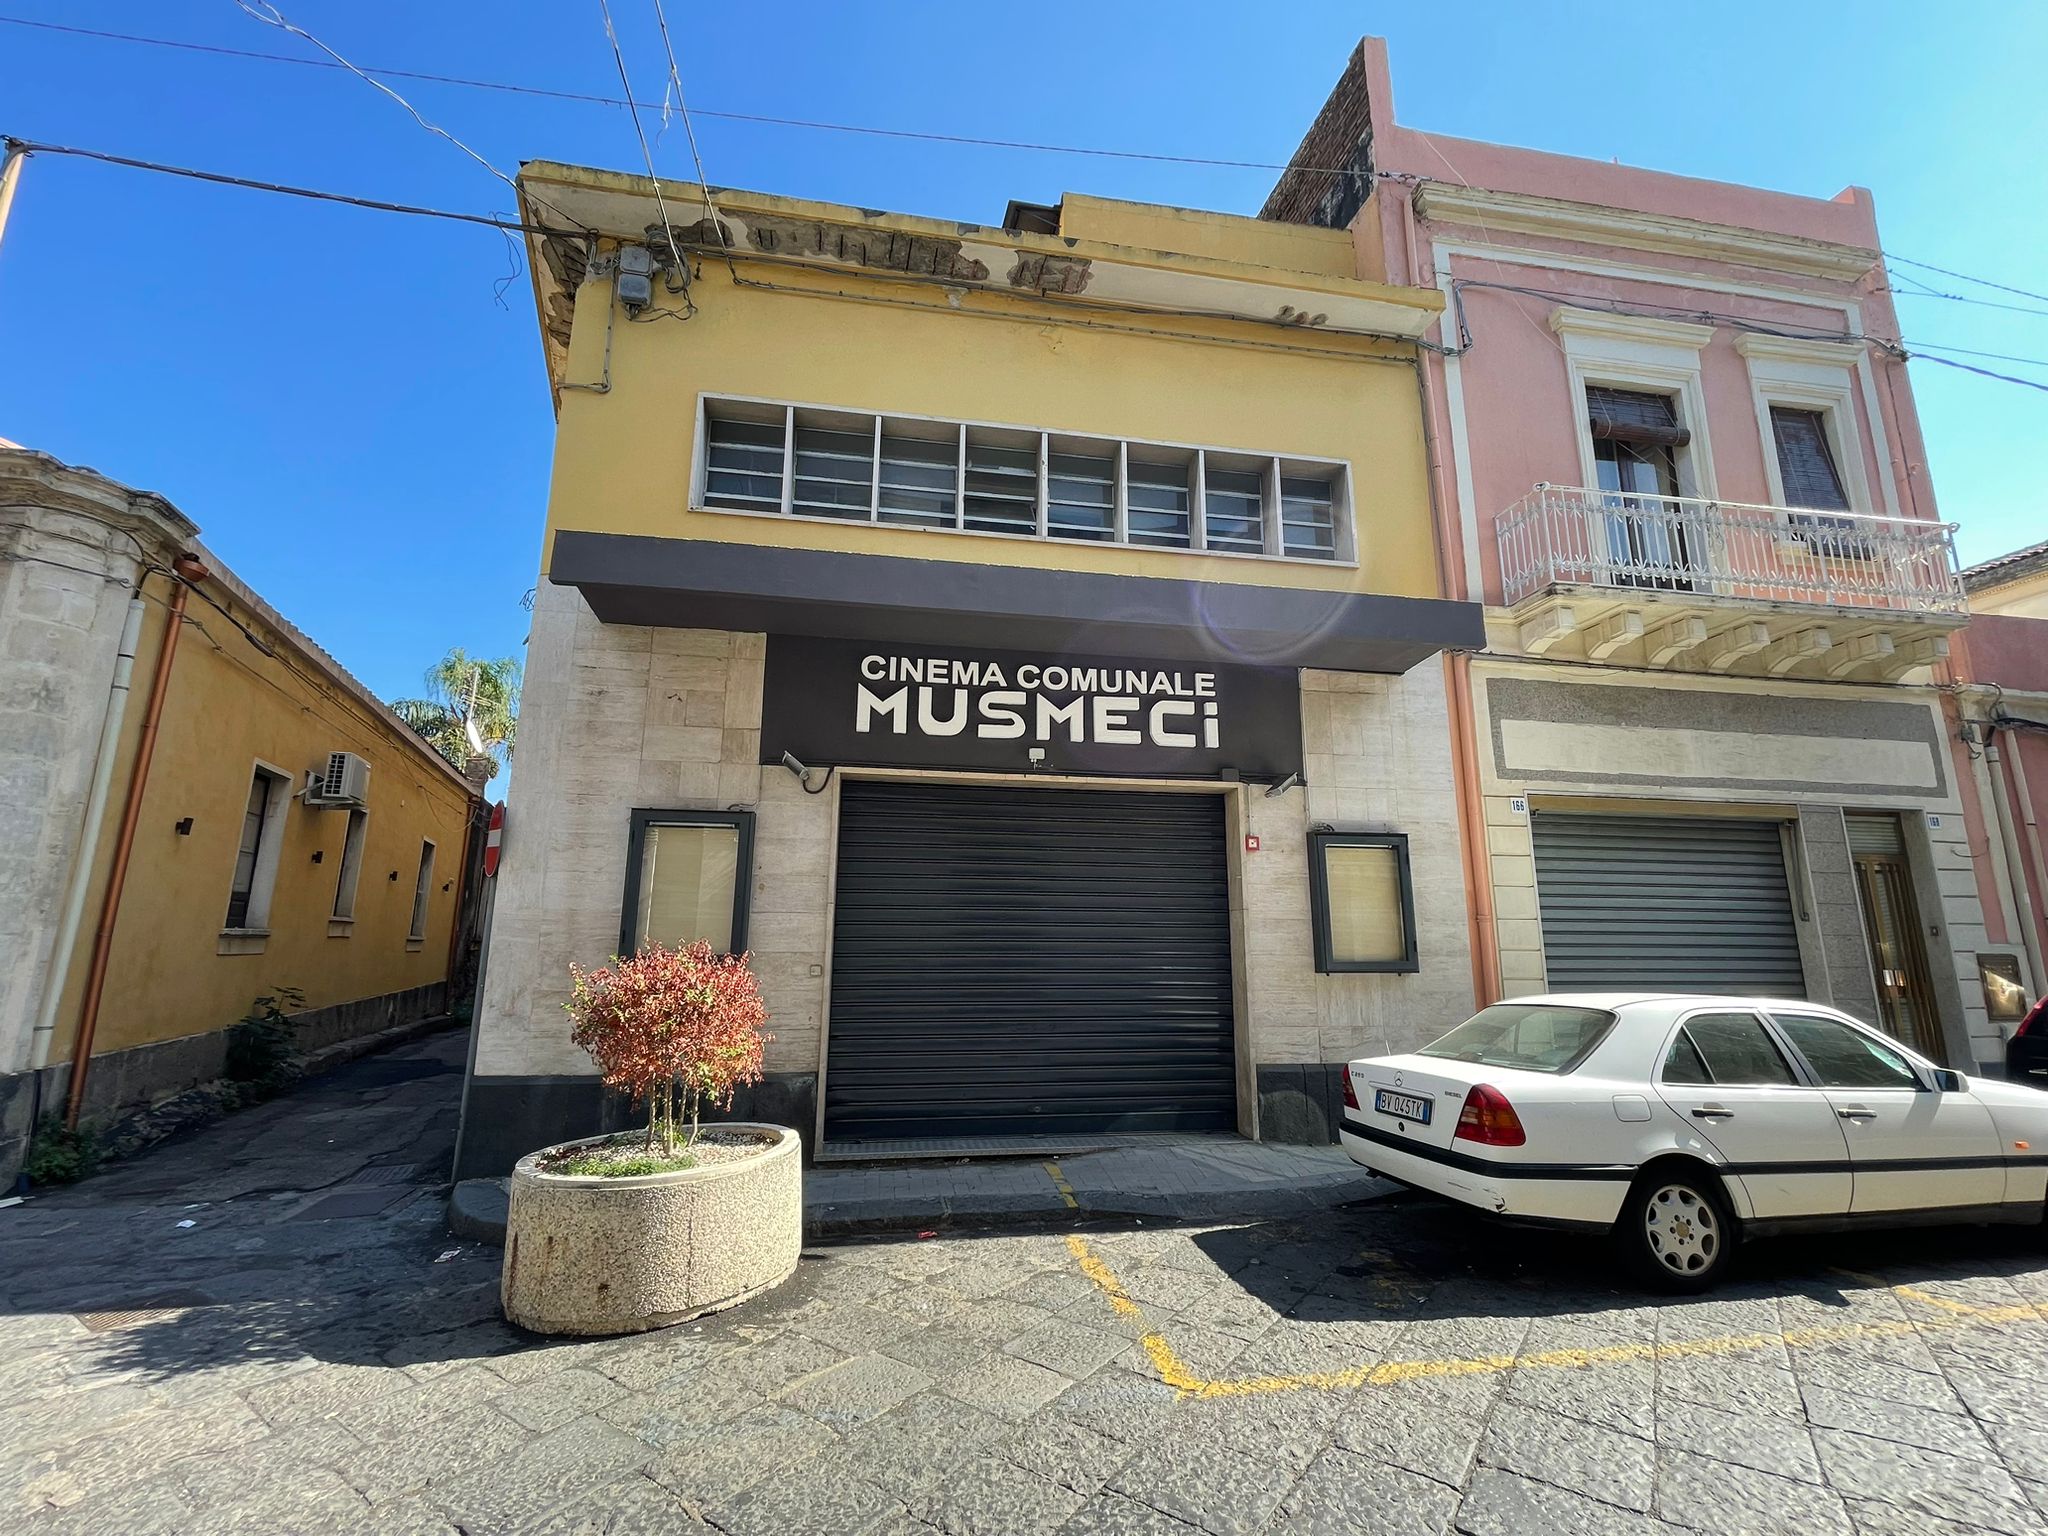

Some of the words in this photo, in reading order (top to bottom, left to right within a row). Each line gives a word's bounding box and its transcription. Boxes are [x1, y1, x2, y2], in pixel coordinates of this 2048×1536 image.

[860, 655, 1007, 687] CINEMA
[1016, 664, 1217, 697] COMUNALE
[1512, 800, 1525, 811] 166
[1381, 1093, 1393, 1110] BV
